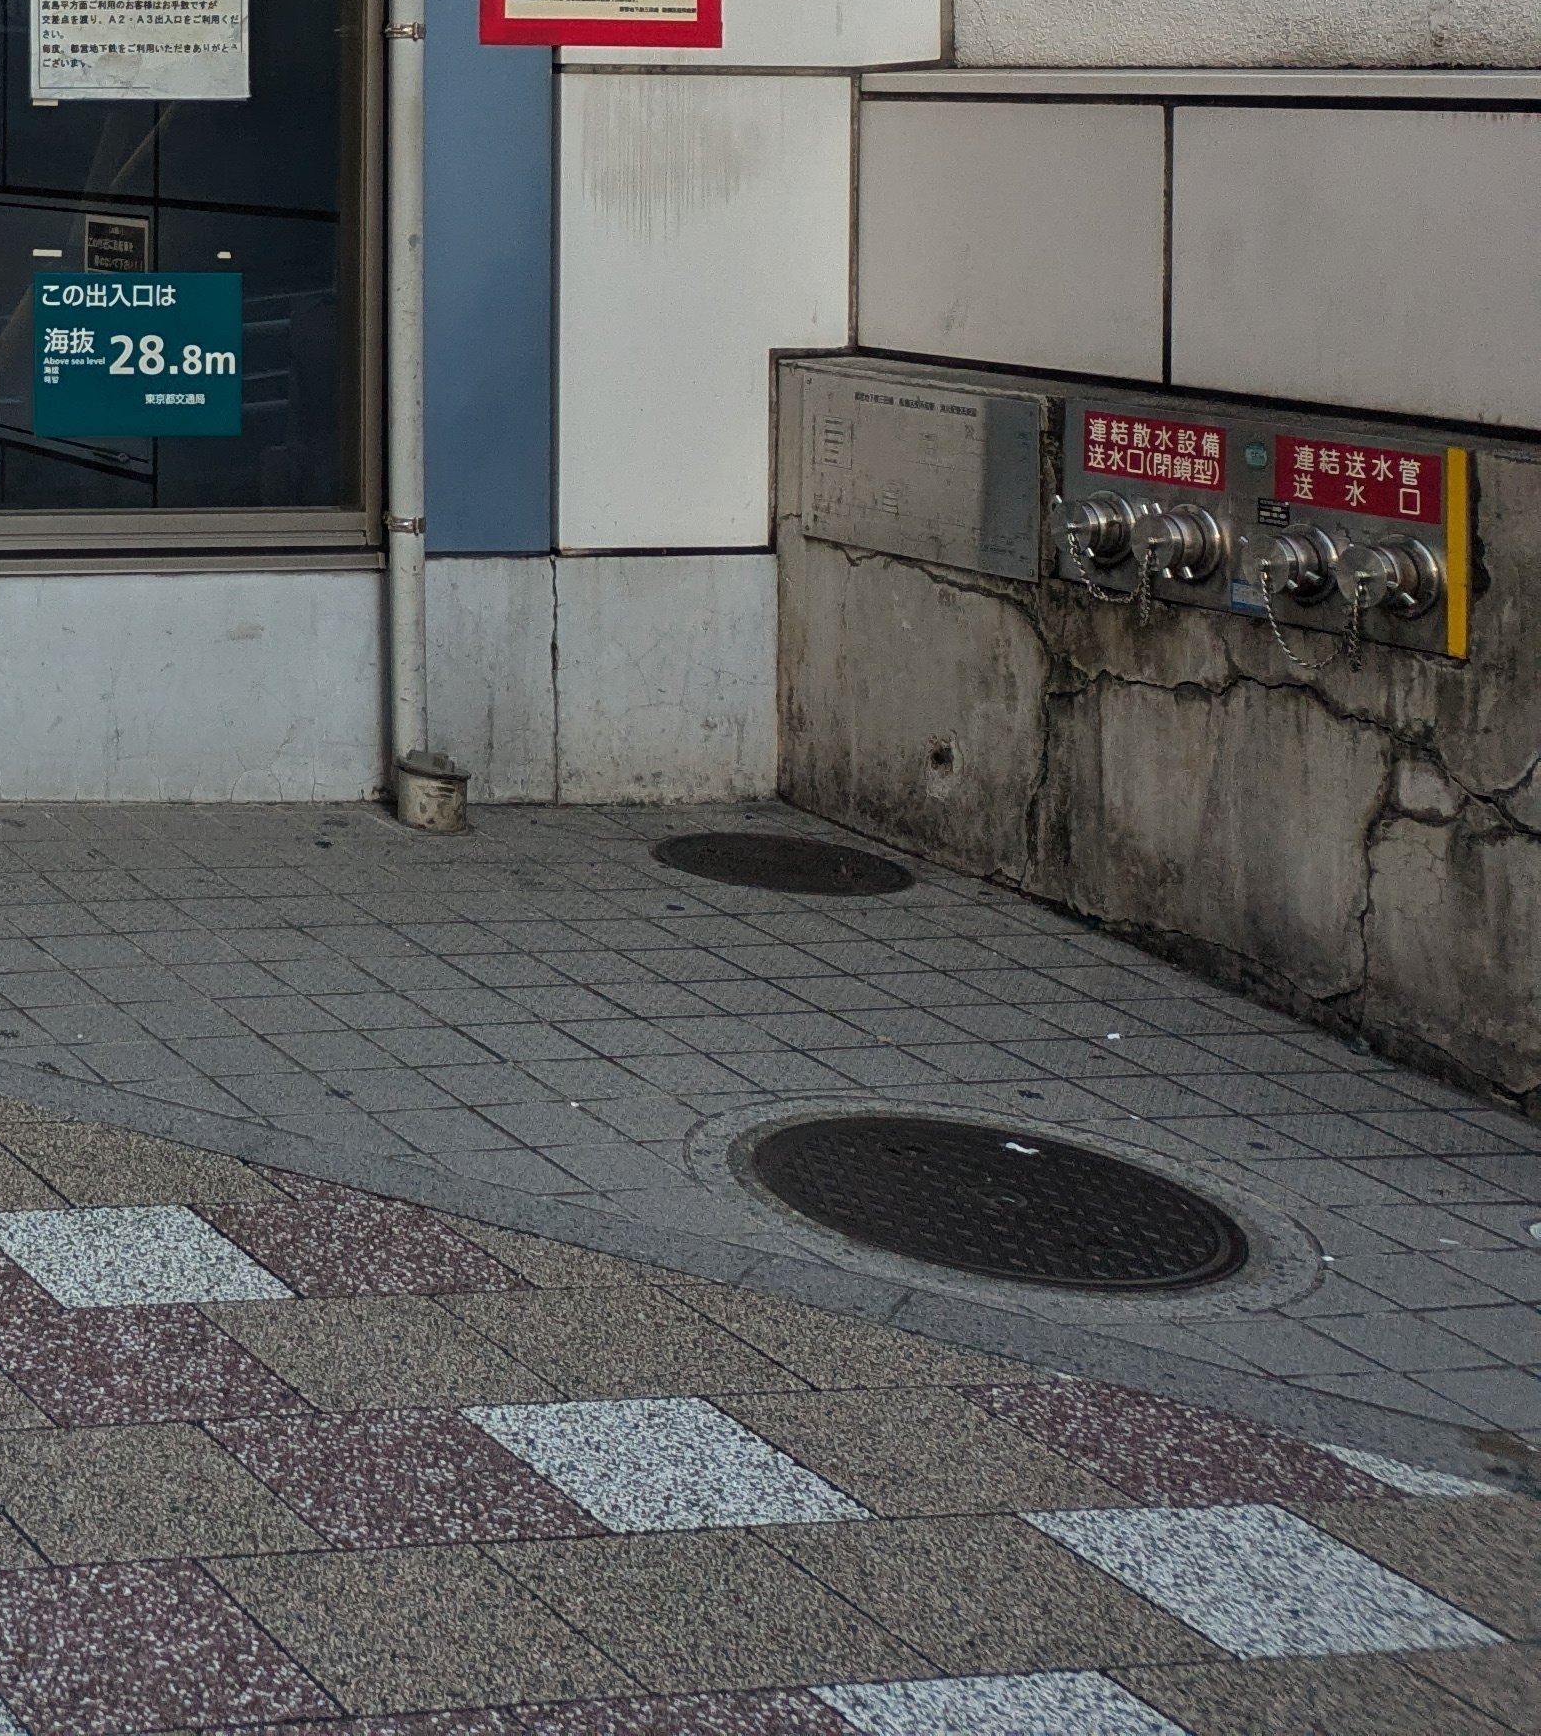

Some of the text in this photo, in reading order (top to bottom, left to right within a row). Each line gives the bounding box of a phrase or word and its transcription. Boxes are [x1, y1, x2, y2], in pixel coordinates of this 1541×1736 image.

[42, 0, 217, 10] 高島平方面ご利用のお客様はお手数ですが
[42, 29, 65, 39] さい。
[42, 283, 177, 307] この出入口は
[43, 327, 236, 375] 海抜 28.8m
[43, 357, 70, 365] Above
[86, 357, 106, 365] level
[145, 393, 206, 405] 東京都交通局
[1088, 417, 1221, 457] 連結散水設備
[1088, 445, 1221, 486] 送水口(閉鎖型)
[1293, 445, 1421, 487] 連結送水管
